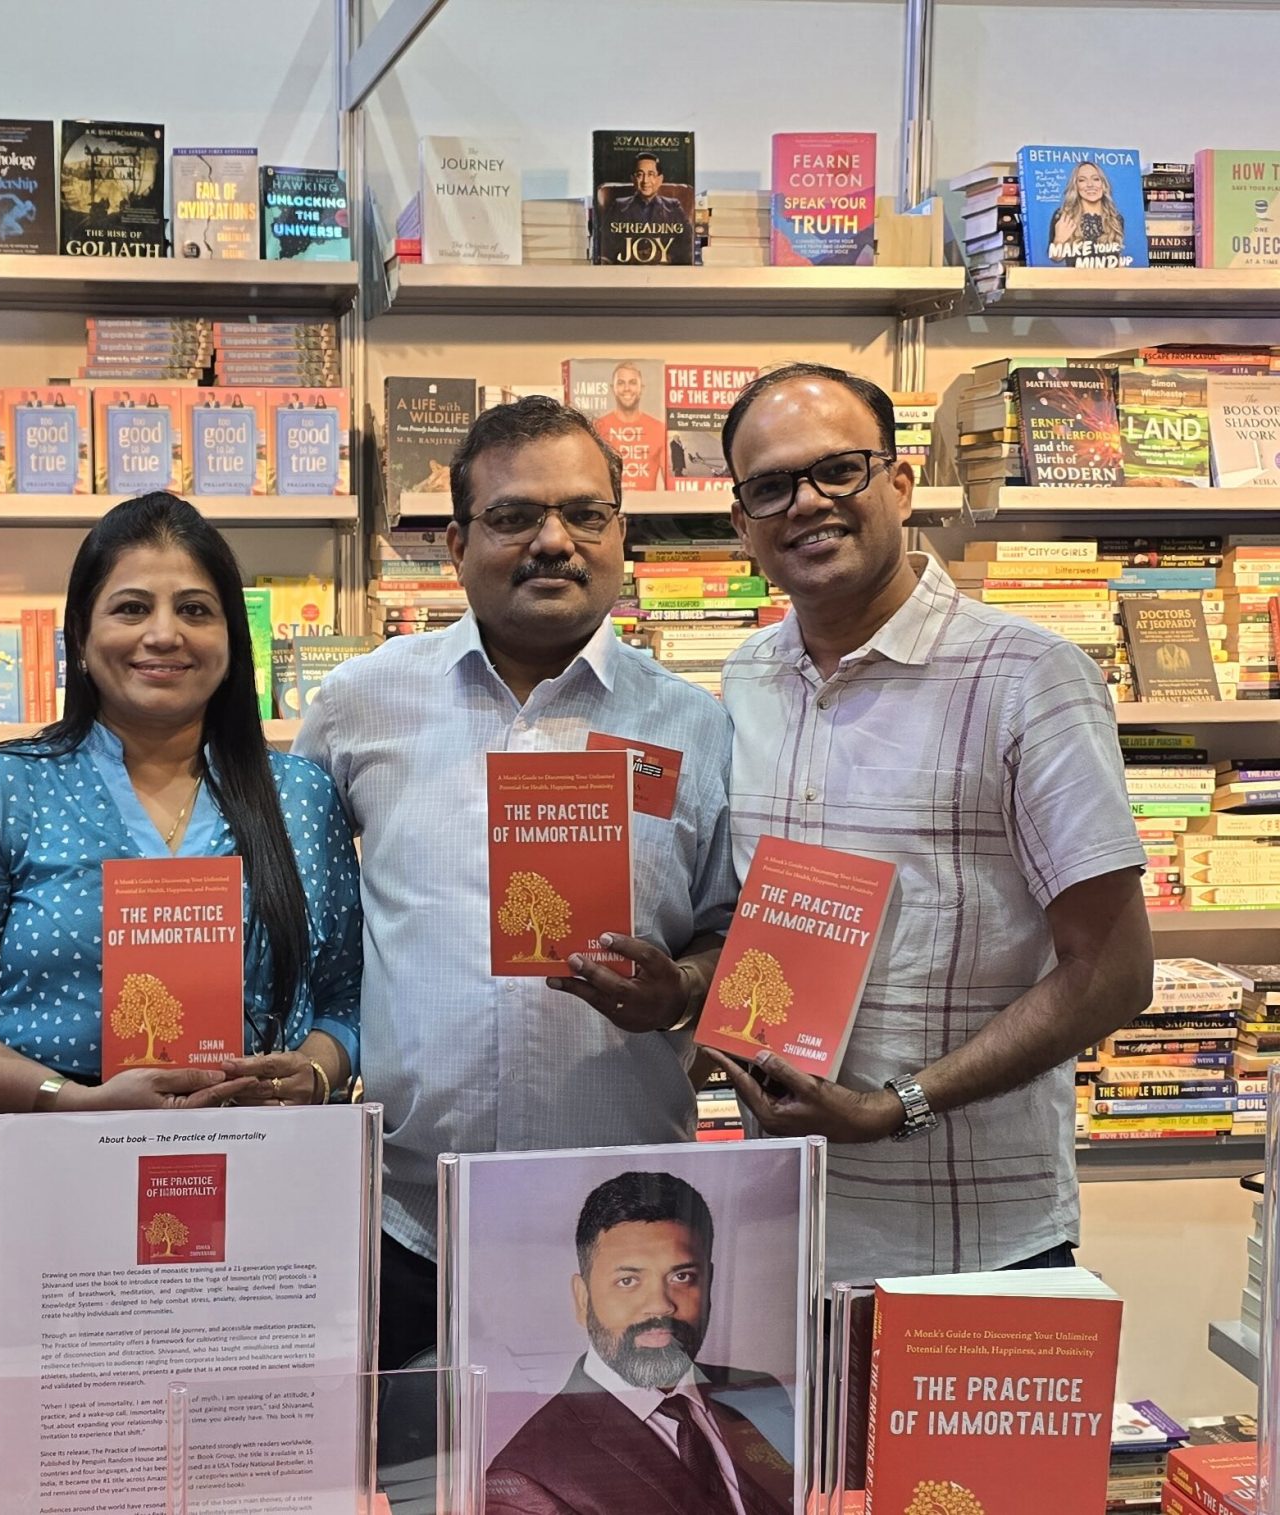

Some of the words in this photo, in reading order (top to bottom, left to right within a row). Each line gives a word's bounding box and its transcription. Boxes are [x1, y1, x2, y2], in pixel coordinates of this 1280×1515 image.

[440, 158, 505, 171] JOURNEY
[793, 153, 860, 169] FEARNE
[1029, 149, 1089, 163] BETHANY
[1095, 152, 1135, 166] MOTA
[1232, 163, 1268, 181] HOW
[272, 181, 339, 193] HAWKING
[789, 173, 863, 188] COTTON
[436, 183, 511, 198] HUMANITY
[267, 193, 346, 208] UNLOCKING
[784, 197, 826, 210] SPEAK
[830, 197, 867, 210] YOUR
[295, 210, 320, 222] THE
[273, 224, 343, 239] UNIVERSE
[610, 221, 683, 236] SPREADING
[791, 214, 858, 235] TRUTH
[85, 228, 106, 239] THE
[108, 229, 128, 239] RISE
[130, 230, 142, 239] OF
[66, 240, 160, 258] GOLIATH
[617, 237, 673, 264] JOY
[1049, 241, 1091, 259] MAKE
[1093, 244, 1120, 255] YOUR
[668, 370, 699, 388] THE
[703, 370, 756, 389] ENEMY
[573, 382, 609, 396] JAMES
[670, 389, 687, 404] OF
[690, 389, 713, 405] THE
[397, 400, 407, 411] A
[411, 399, 437, 412] LIFE
[439, 401, 461, 412] with
[574, 396, 608, 410] SMITH
[410, 411, 470, 425] WILDLIFE
[25, 423, 68, 447] good
[118, 423, 160, 447] good
[286, 424, 330, 448] good
[609, 427, 644, 442] NOT
[1128, 417, 1202, 442] LAND
[1236, 431, 1276, 441] WORK
[30, 453, 67, 473] true
[122, 453, 159, 473] true
[290, 454, 327, 474] true
[1038, 466, 1116, 482] MODERN
[1028, 547, 1049, 558] CITY
[1051, 548, 1061, 556] OF
[1062, 547, 1088, 558] GIRLS
[1140, 608, 1191, 620] DOCTORS
[504, 804, 531, 821] THE
[538, 803, 609, 820] PRACTICE
[493, 826, 509, 843] OF
[516, 825, 623, 843] IMMORTALITY
[760, 883, 787, 905] THE
[791, 891, 864, 924] PRACTICE
[120, 907, 148, 924] THE
[153, 905, 223, 923] PRACTICE
[740, 902, 761, 919] OF
[762, 907, 870, 948] IMMORTALITY
[108, 929, 125, 946] OF
[131, 926, 236, 946] IMMORTALITY
[783, 1043, 827, 1063] SHIVANAND
[1099, 1087, 1116, 1098] THE
[1117, 1085, 1150, 1097] SIMPLE
[1151, 1084, 1180, 1096] TRUTH
[99, 1134, 124, 1144] About
[126, 1134, 148, 1143] book
[156, 1133, 171, 1142] The
[173, 1132, 206, 1142] Practice
[207, 1132, 216, 1143] of
[218, 1131, 267, 1143] Immortality
[41, 1272, 68, 1280] Drawing
[190, 1266, 213, 1274] training
[904, 1329, 912, 1338] A
[914, 1329, 945, 1339] Monk's
[946, 1330, 971, 1339] Guide
[973, 1331, 982, 1339] to
[984, 1331, 1032, 1342] Discovering
[1034, 1331, 1053, 1341] Your
[1055, 1332, 1098, 1341] Unlimited
[906, 1344, 943, 1354] Potential
[945, 1344, 957, 1354] for
[959, 1345, 990, 1355] Health,
[991, 1346, 1036, 1357] Happiness,
[1038, 1347, 1054, 1356] and
[1056, 1347, 1095, 1359] Positivity
[913, 1376, 957, 1401] THE
[967, 1376, 1084, 1403] PRACTICE
[890, 1410, 919, 1435] OF
[928, 1411, 1102, 1437] IMMORTALITY
